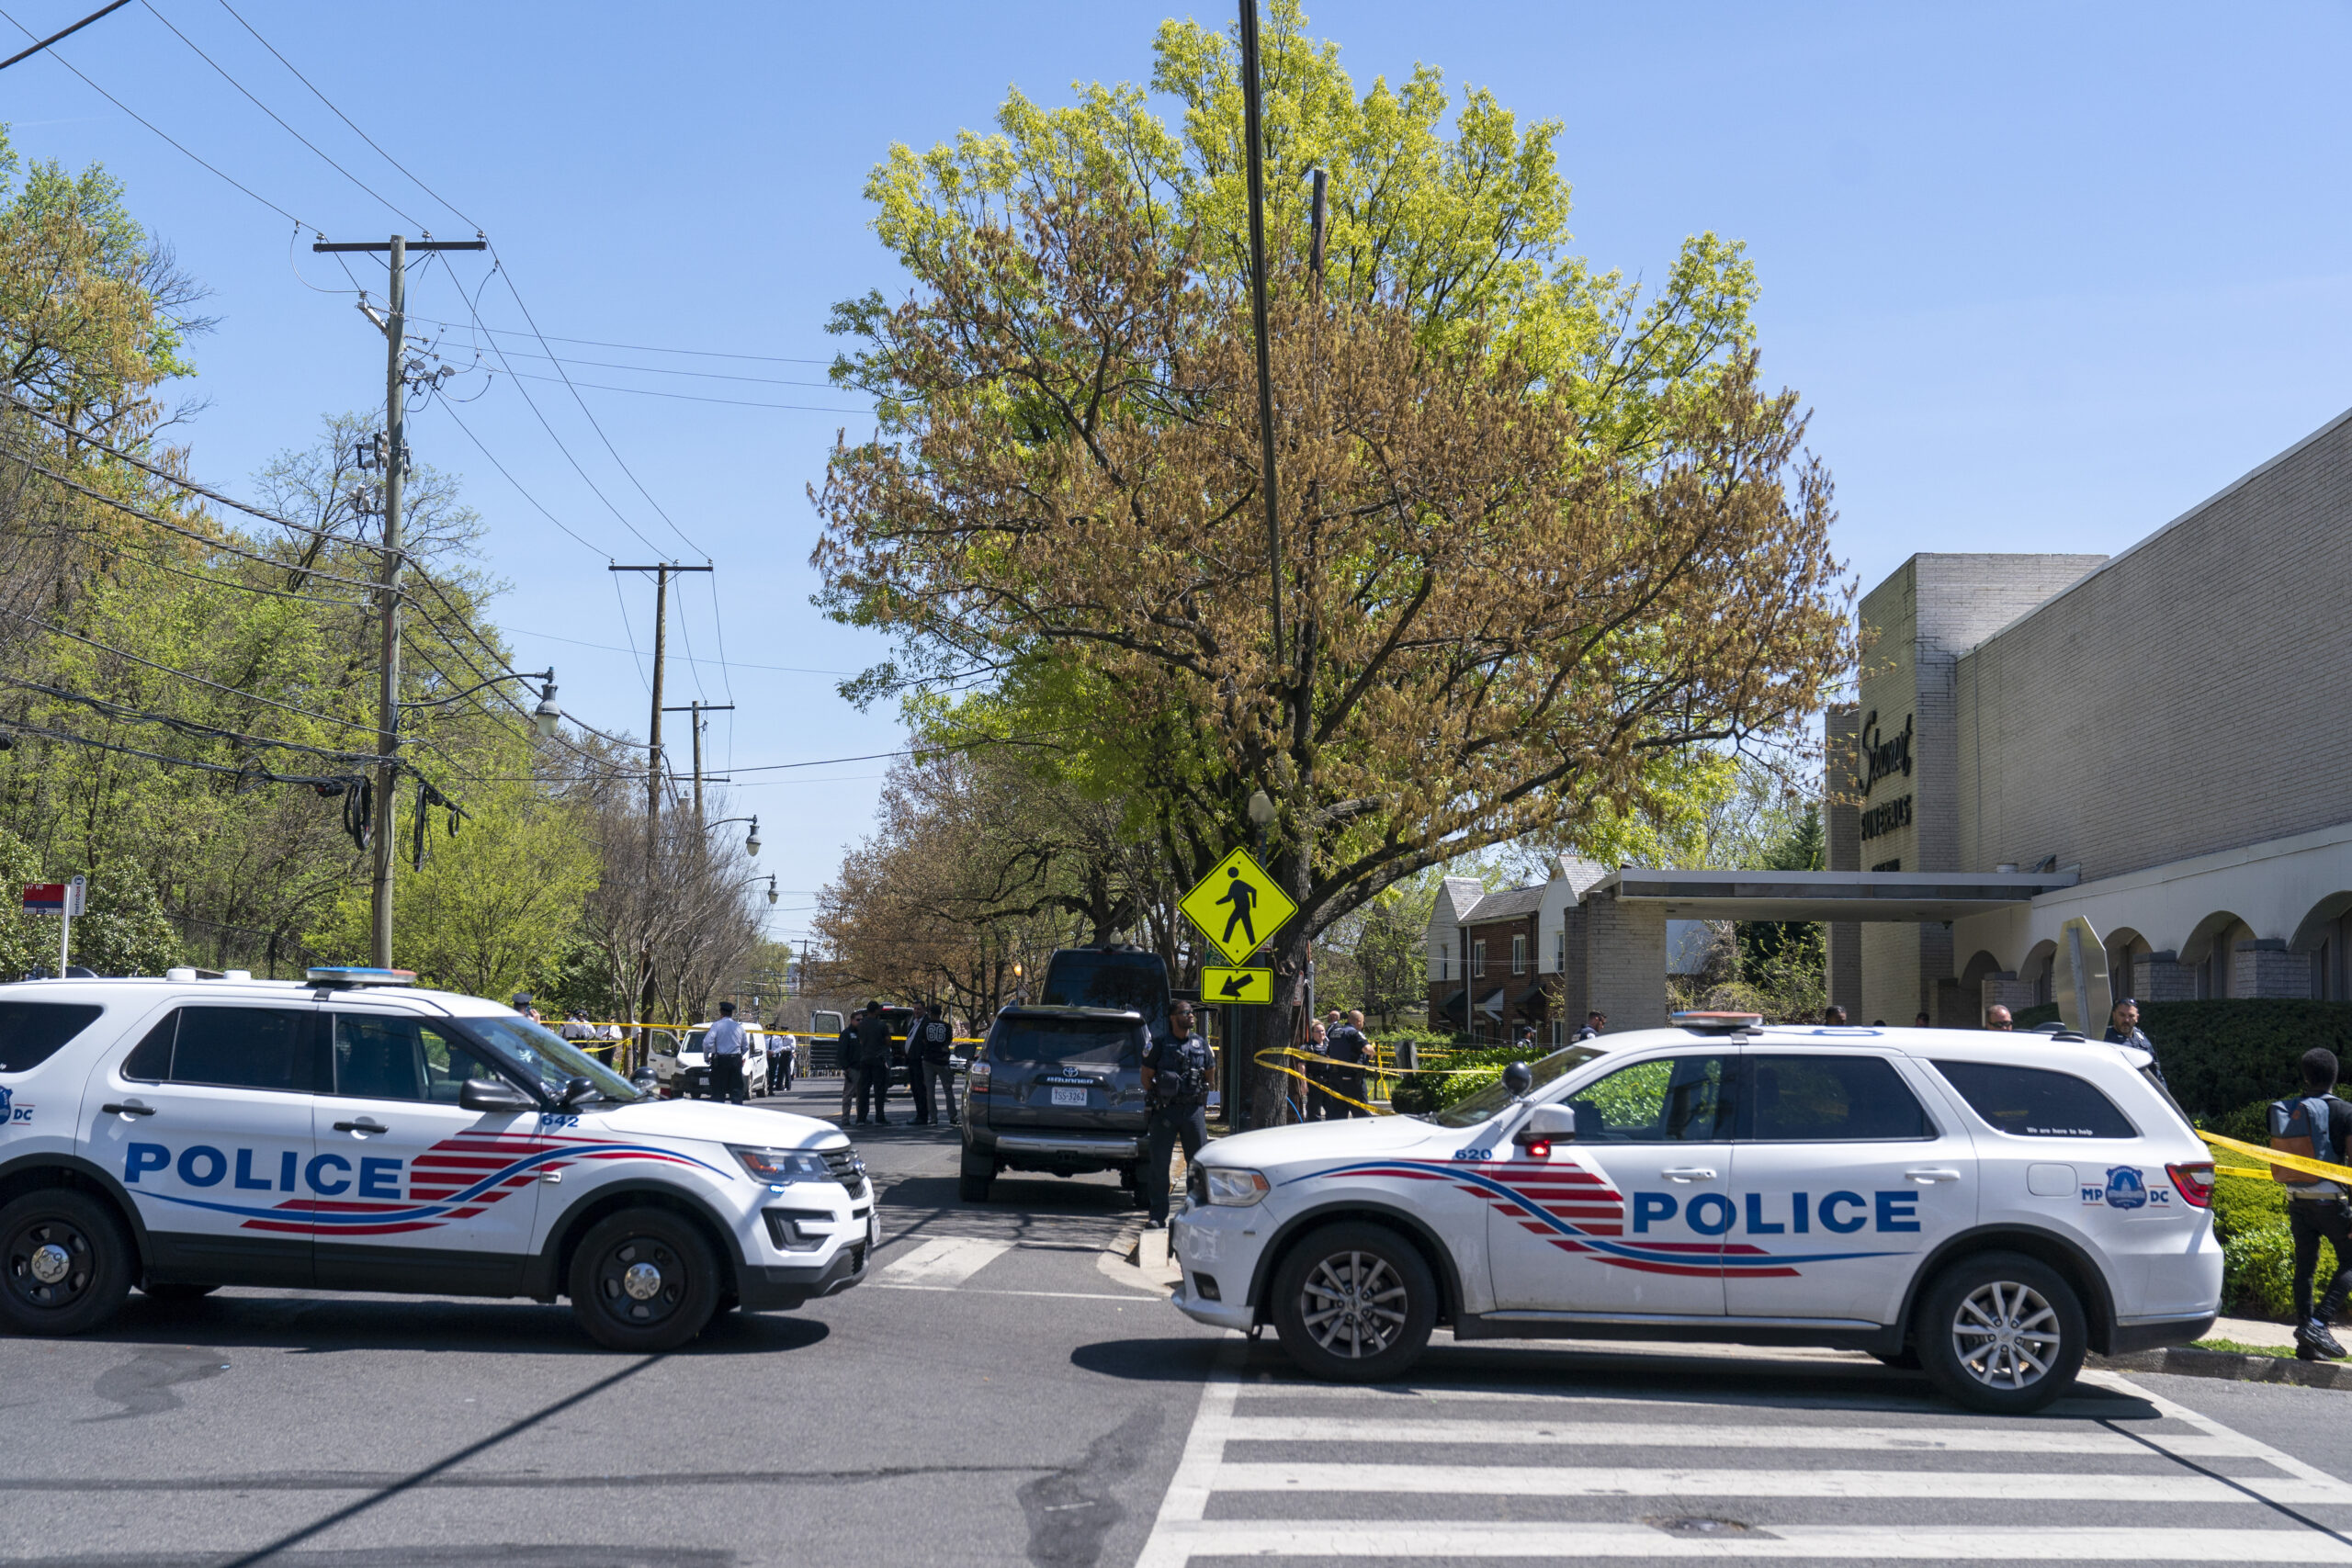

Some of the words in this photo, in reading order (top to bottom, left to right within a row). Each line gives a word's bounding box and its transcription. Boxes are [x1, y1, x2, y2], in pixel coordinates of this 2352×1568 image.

[13, 1109, 33, 1121] DC
[542, 1113, 579, 1127] 642
[2078, 1128, 2093, 1136] help
[1454, 1148, 1492, 1160] 620
[124, 1142, 403, 1200] POLICE
[2081, 1189, 2103, 1201] MP
[2150, 1190, 2169, 1202] DC
[1633, 1190, 1921, 1236] POLICE
